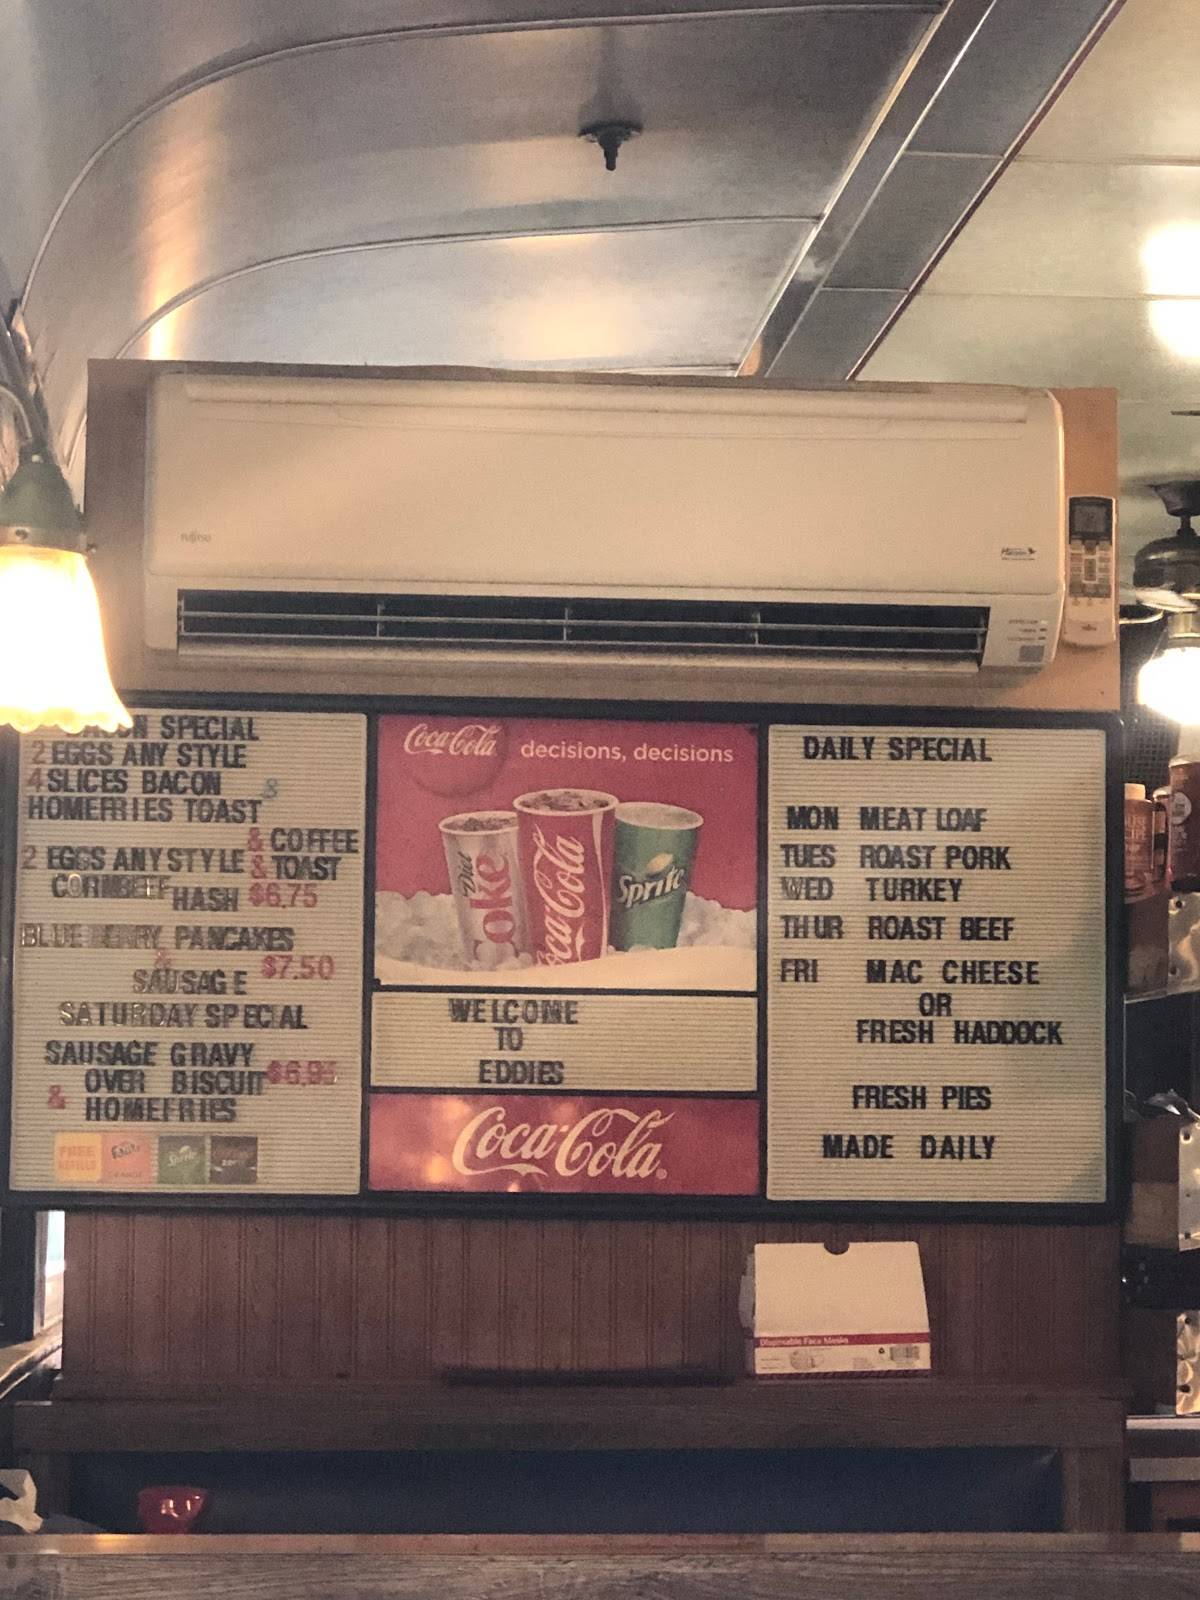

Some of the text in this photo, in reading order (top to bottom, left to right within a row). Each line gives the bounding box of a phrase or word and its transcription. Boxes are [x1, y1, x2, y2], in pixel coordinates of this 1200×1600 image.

[161, 715, 259, 740] SPECIAL
[404, 724, 502, 756] Coca-Cola
[31, 740, 247, 769] 2 EGGS ANY STYLE
[521, 740, 734, 763] decisions, decisions
[802, 735, 992, 762] DAILY SPECIAL
[27, 768, 222, 795] 4 SLICES BACON
[186, 799, 262, 823] TOAST
[787, 806, 988, 832] MON MEAT LOAF
[271, 828, 359, 853] COFFEE
[22, 847, 38, 869] 2
[47, 846, 106, 870] EGGS
[271, 855, 342, 880] TOAST
[780, 844, 1011, 870] TUES ROAST PORK
[173, 887, 239, 911] HASH
[249, 882, 318, 908] $6.75
[616, 865, 685, 908] Sprite
[781, 877, 962, 902] WED TURKEY
[175, 925, 294, 950] PANCAKES
[780, 915, 1015, 941] THUR ROAST BEEF
[262, 955, 334, 980] $7.50
[780, 959, 1040, 985] FRI MAC CHEESE
[58, 1001, 197, 1027] SATURDAY
[448, 998, 578, 1025] WELCOME
[919, 993, 952, 1017] OR
[494, 1027, 523, 1051] TO
[857, 1020, 1063, 1045] FRESH HADDOCK
[44, 1040, 255, 1067] SAUSAGE GRAVY
[85, 1069, 145, 1094] OVER
[172, 1071, 266, 1096] BISCUIT
[478, 1059, 564, 1085] EDDIES
[85, 1097, 237, 1122] HOMEFRIES
[852, 1085, 991, 1110] FRESH PIES
[452, 1106, 676, 1179] Coca-Cola
[822, 1134, 995, 1160] MADE DAILY
